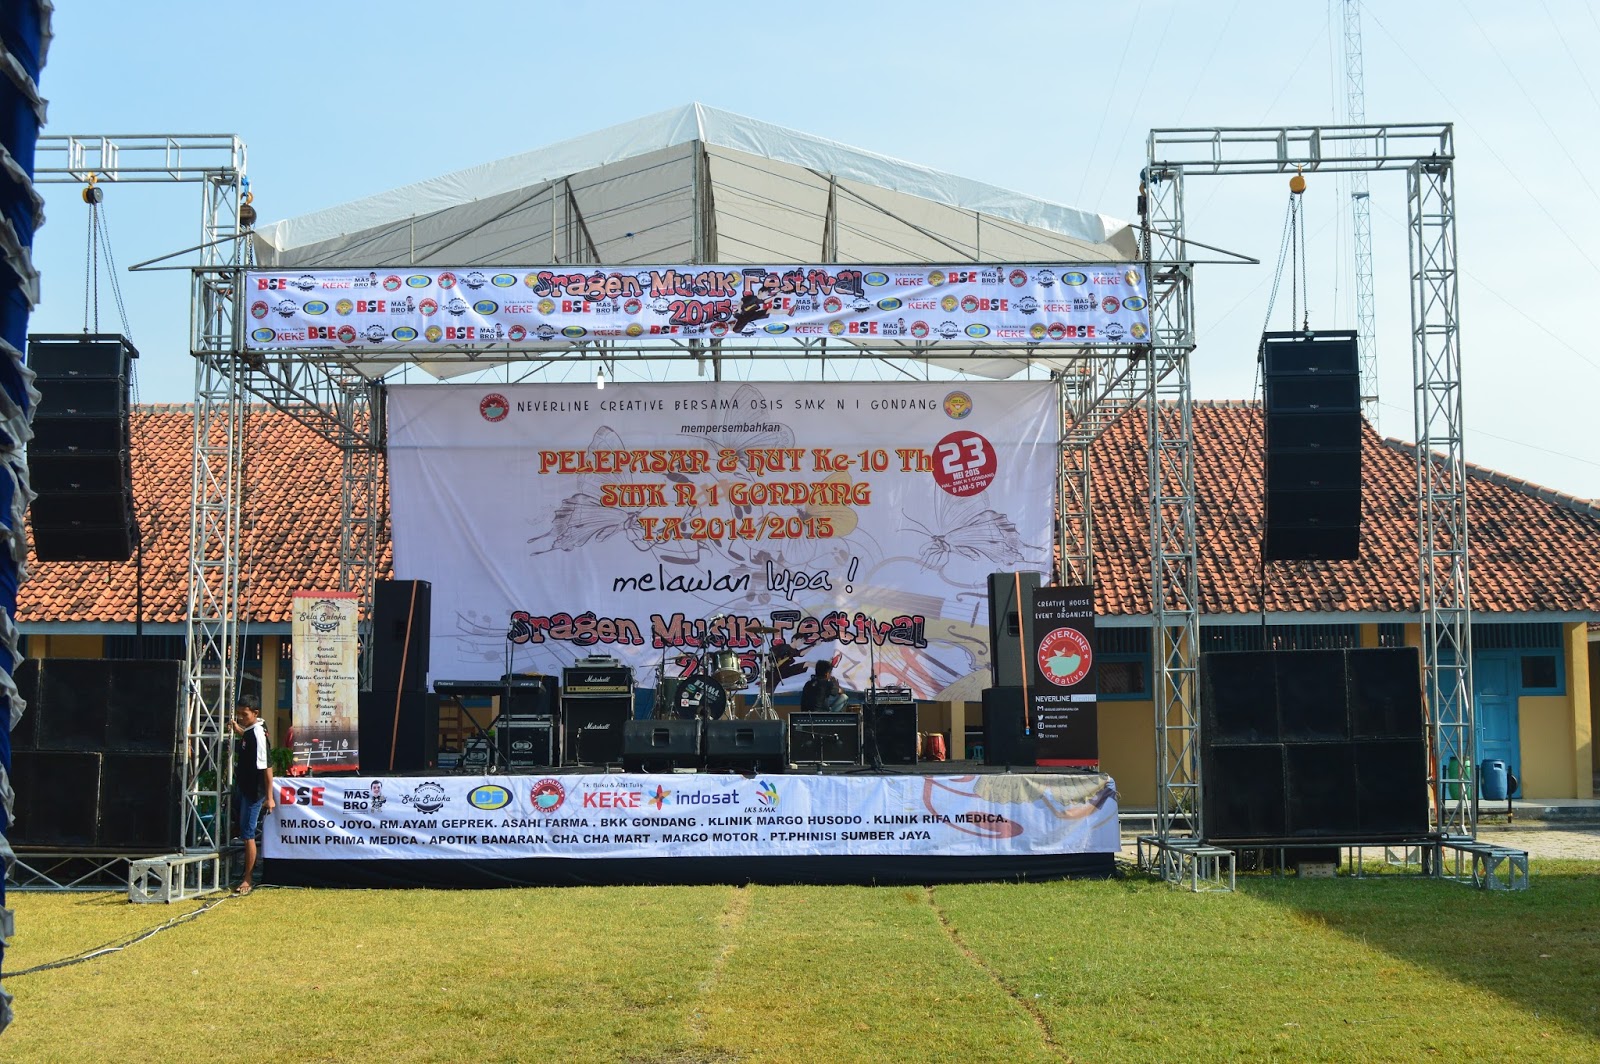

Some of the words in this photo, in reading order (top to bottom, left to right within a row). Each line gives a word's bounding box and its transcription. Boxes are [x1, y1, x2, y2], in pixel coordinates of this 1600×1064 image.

[258, 278, 287, 290] BSE
[896, 278, 923, 286] KEKE
[949, 272, 977, 284] BSE
[1094, 277, 1120, 285] KEKE
[533, 270, 643, 302] Sragen
[650, 269, 736, 298] Musik
[742, 268, 864, 297] Festival
[356, 300, 386, 312] BSE
[504, 305, 532, 314] KEKE
[562, 300, 591, 312] BSE
[908, 302, 936, 310] KEKE
[980, 298, 1008, 311] BSE
[1044, 304, 1072, 312] KEKE
[667, 299, 732, 326] 2015
[308, 326, 336, 340] BSE
[446, 326, 475, 340] BSE
[795, 326, 823, 334] KEKE
[849, 322, 878, 334] BSE
[996, 330, 1024, 338] KEKE
[1067, 326, 1096, 338] BSE
[277, 332, 304, 341] KEKE
[518, 401, 589, 412] NEVERLINE
[600, 400, 664, 412] CREATIVE
[675, 399, 738, 410] BERSAMA
[751, 399, 782, 410] OSIS
[795, 399, 825, 410] SMK
[838, 399, 844, 410] N
[871, 399, 937, 410] GONDANG
[681, 422, 780, 435] mempersembahkan
[538, 449, 710, 474] PELEPASAN
[718, 448, 739, 472] &
[747, 448, 806, 476] HUT
[812, 449, 888, 472] Ke-10
[895, 448, 934, 472] Th
[939, 437, 986, 474] 23
[953, 472, 964, 480] MEI
[964, 468, 980, 478] 2015
[976, 480, 986, 488] PM
[601, 484, 668, 507] SMK
[674, 483, 698, 507] N
[706, 487, 719, 507] 1
[730, 482, 872, 506] GONDANG
[638, 518, 684, 541] T.A
[690, 516, 834, 542] 2014/2015
[612, 564, 750, 593] melawan
[766, 560, 832, 600] lupa
[507, 610, 644, 646] Sragen
[650, 613, 762, 648] Musik
[770, 610, 927, 648] Festival
[1042, 630, 1088, 652] NEVERLINE
[1046, 670, 1084, 684] creative
[280, 786, 326, 806] BSE
[344, 791, 370, 800] MAS
[402, 794, 420, 804] Sela
[423, 794, 450, 804] Saloka
[583, 792, 641, 808] KEKE
[676, 790, 740, 804] indosat
[344, 802, 368, 810] BRO
[280, 819, 335, 828] RM.ROSO
[340, 820, 375, 829] JOYO.
[380, 820, 437, 828] RM.AYAM
[442, 819, 497, 828] GEPREK.
[502, 818, 540, 828] ASAHI
[546, 818, 588, 828] FARMA
[600, 818, 627, 827] BKK
[632, 818, 696, 827] GONDANG
[708, 816, 752, 826] KLINIK
[757, 816, 803, 825] MARGO
[808, 816, 862, 825] HUSODO
[874, 815, 918, 824] KLINIK
[923, 814, 950, 824] RIFA
[955, 814, 1008, 823] MEDICA.
[281, 835, 321, 844] KLINIK
[325, 836, 364, 844] PRIMA
[370, 836, 418, 844] MEDICA
[430, 835, 477, 844] APOTIK
[482, 835, 548, 844] BANARAN.
[552, 834, 579, 844] CHA
[584, 834, 610, 844] CHA
[614, 834, 650, 843] MART
[662, 833, 708, 842] MARCO
[712, 832, 758, 842] MOTOR
[770, 832, 836, 841] PT.PHINISI
[841, 832, 894, 840] SUMBER
[899, 831, 931, 840] JAYA
